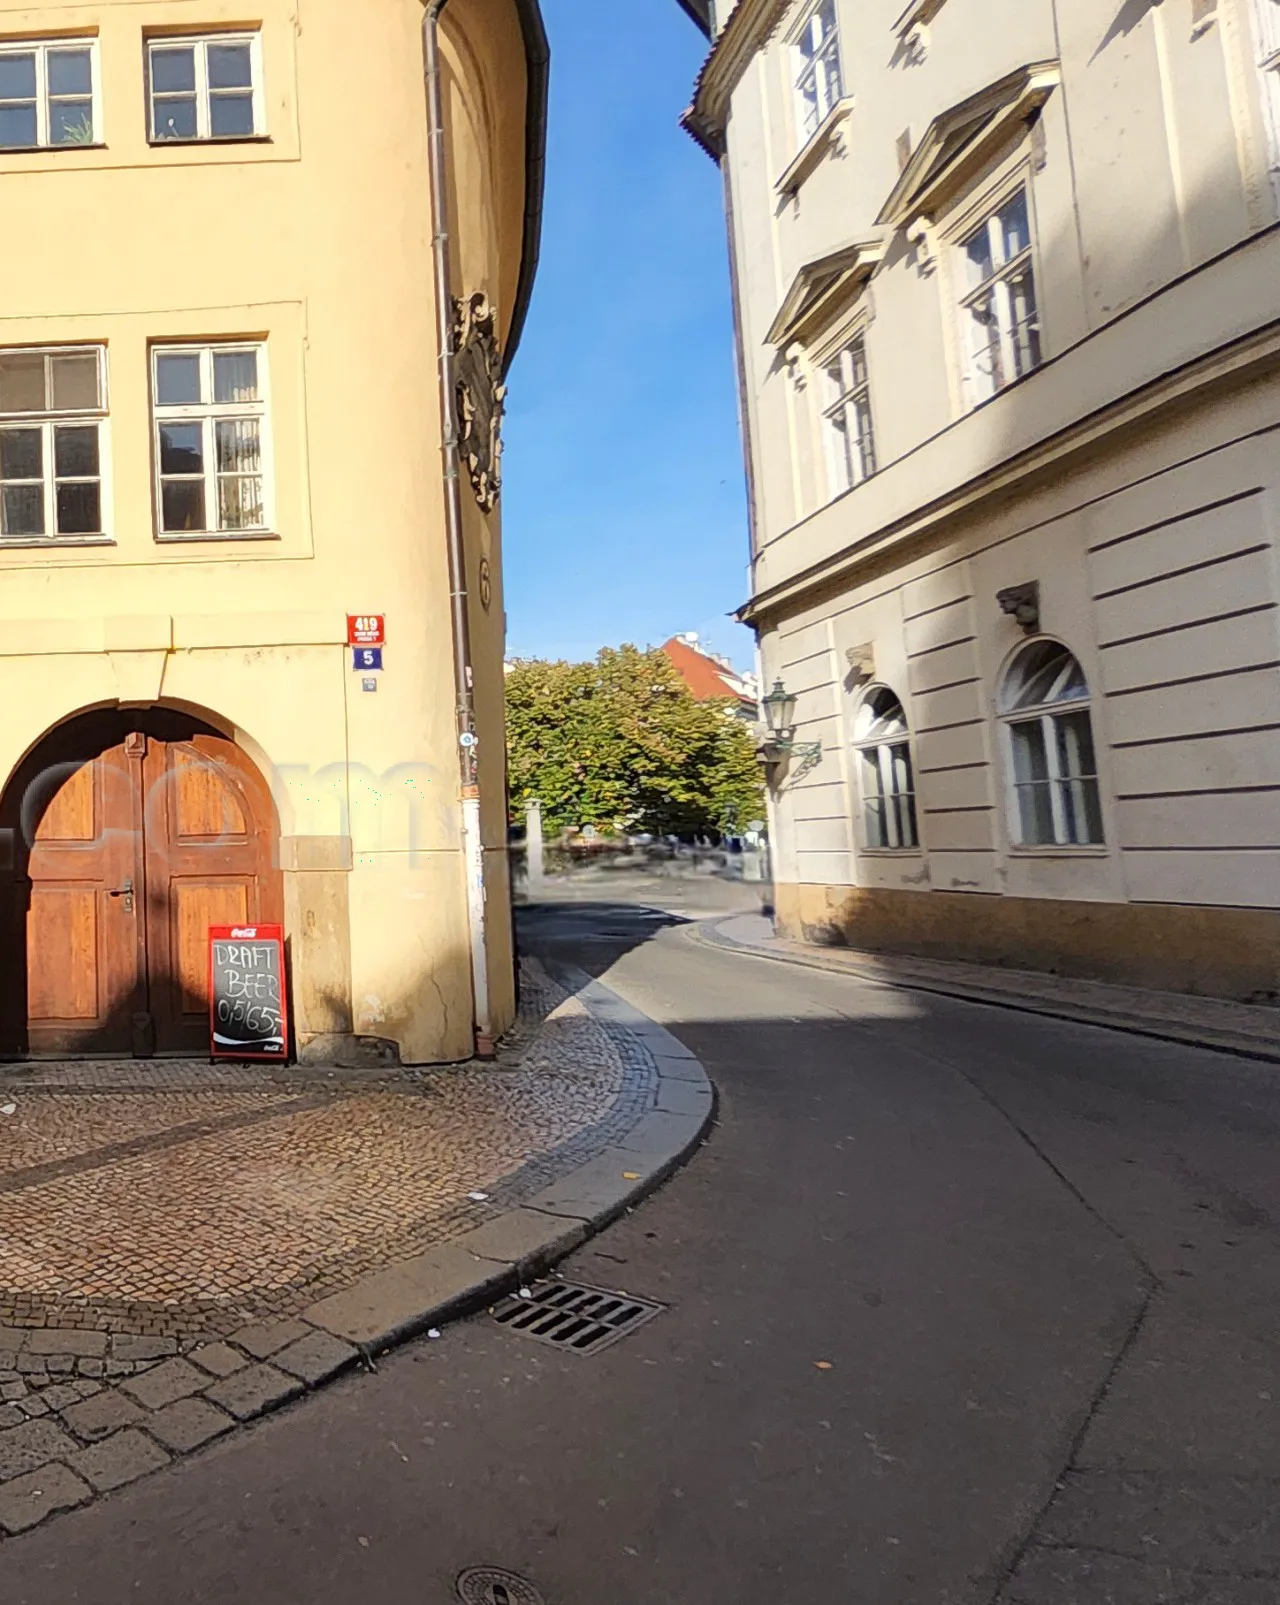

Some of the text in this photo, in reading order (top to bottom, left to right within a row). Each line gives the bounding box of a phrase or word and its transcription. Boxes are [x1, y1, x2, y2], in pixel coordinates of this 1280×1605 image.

[355, 617, 377, 631] 419
[363, 650, 374, 665] 5
[214, 944, 275, 968] DRAFT
[223, 970, 280, 1002] BEER
